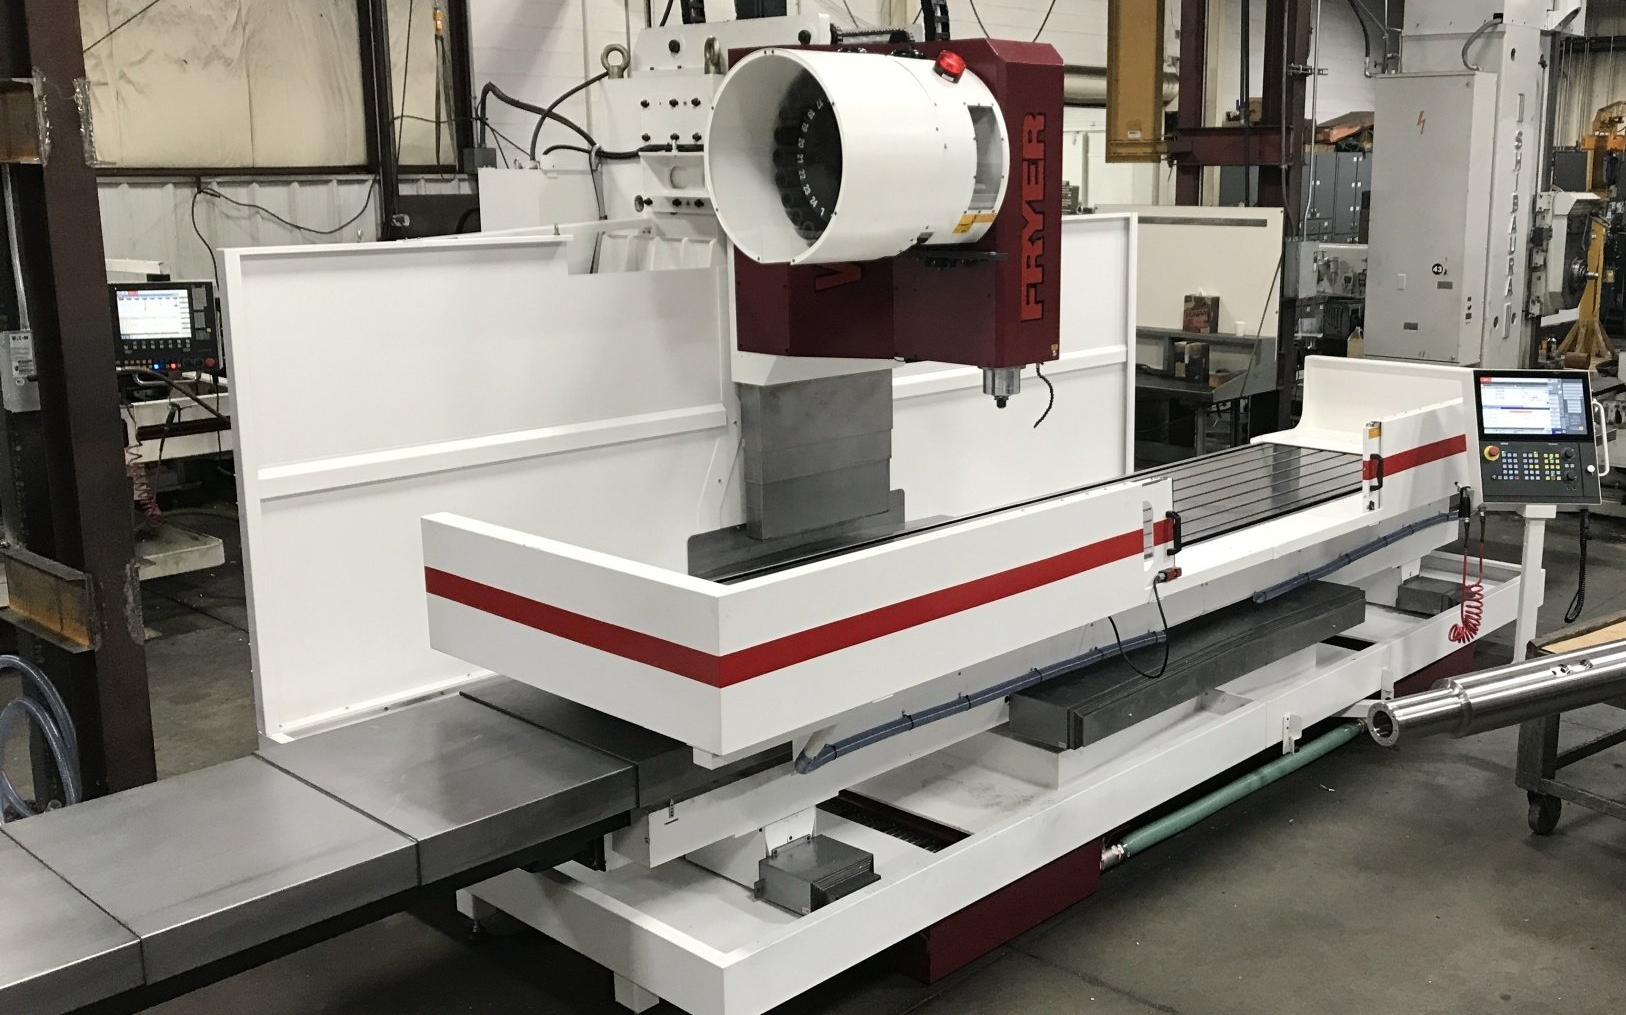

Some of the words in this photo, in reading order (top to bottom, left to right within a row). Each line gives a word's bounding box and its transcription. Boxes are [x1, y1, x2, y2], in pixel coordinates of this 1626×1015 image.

[797, 137, 805, 149] 20
[796, 153, 804, 163] 21
[798, 169, 806, 180] 22
[803, 183, 811, 196] 23
[809, 195, 818, 208] 24
[1021, 112, 1045, 321] FRYER
[1504, 130, 1523, 297] SHIBAURA
